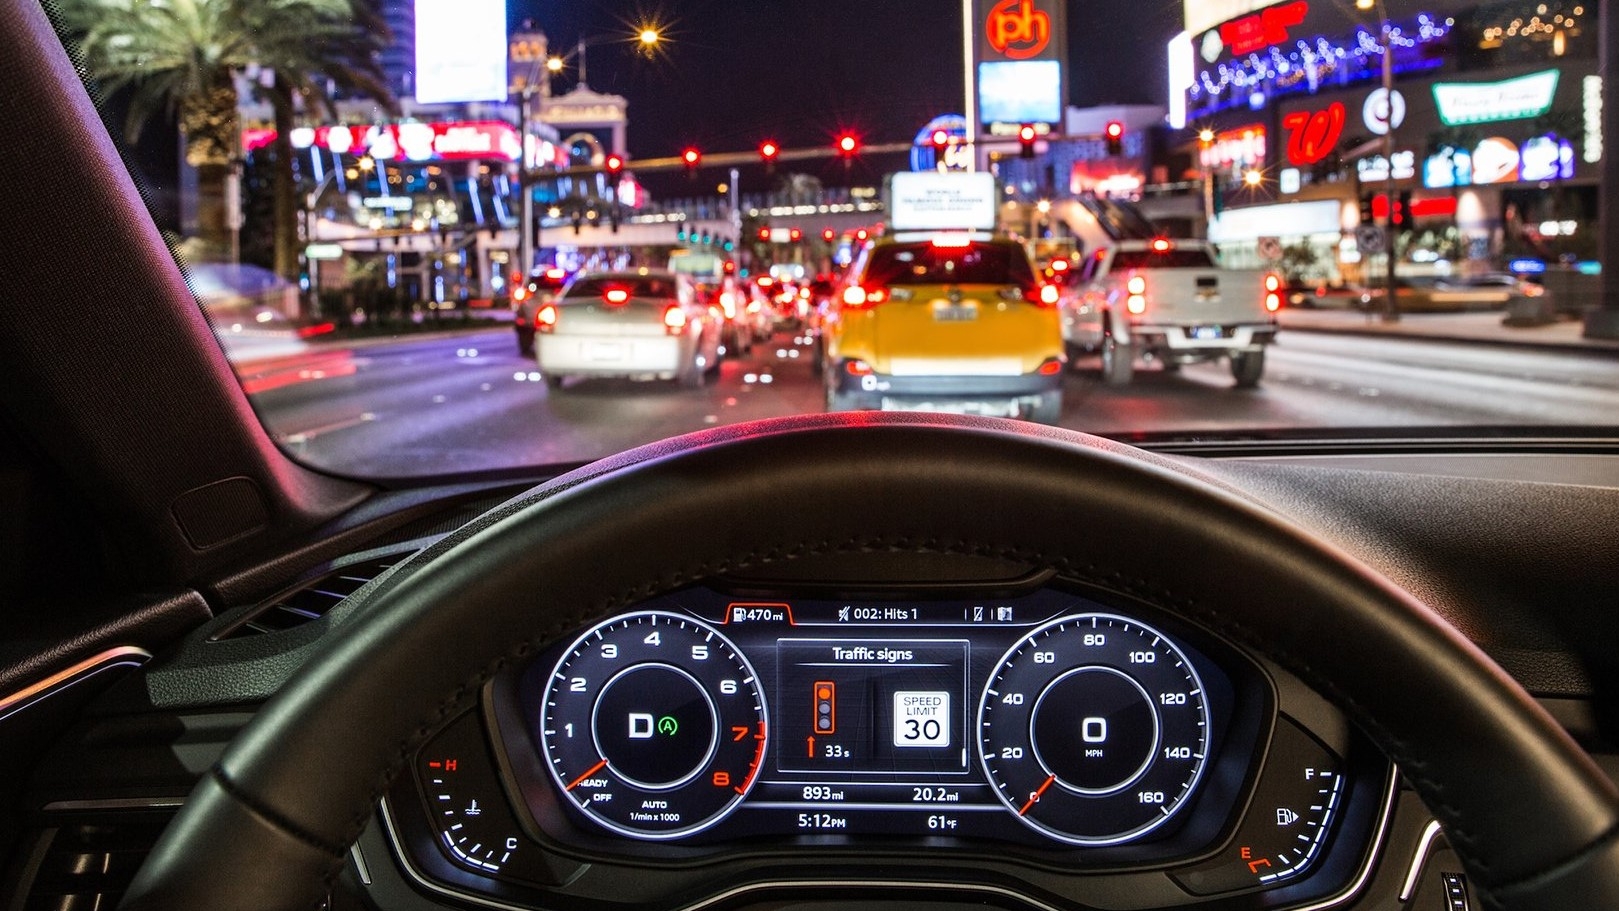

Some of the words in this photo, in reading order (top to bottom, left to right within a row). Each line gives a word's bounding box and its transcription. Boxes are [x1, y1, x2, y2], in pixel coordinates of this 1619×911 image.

[1282, 101, 1346, 166] W
[854, 608, 881, 620] 002:
[884, 608, 908, 620] Hits
[911, 608, 918, 620] 1
[644, 631, 661, 646] 4
[1084, 634, 1105, 646] 80
[601, 644, 618, 659] 3
[692, 645, 708, 660] 5
[833, 647, 874, 661] Traffic
[877, 648, 913, 664] signs
[1033, 651, 1055, 663] 60
[1129, 651, 1155, 663] 100
[570, 678, 587, 692] 2
[720, 679, 737, 694] 6
[903, 697, 941, 706] SPEED
[1002, 693, 1024, 705] 40
[1160, 693, 1186, 705] 120
[907, 706, 938, 716] LIMIT
[564, 723, 573, 738] 1
[628, 712, 654, 739] D
[904, 718, 940, 741] 30
[1082, 716, 1107, 743] 0
[731, 726, 748, 742] 7
[1002, 747, 1023, 759] 20
[1085, 750, 1103, 758] MPH
[1164, 747, 1190, 759] 140
[445, 759, 457, 771] H
[713, 772, 729, 786] 8
[1305, 768, 1314, 780] F
[593, 792, 612, 802] OFF
[1138, 792, 1164, 804] 160
[642, 800, 668, 809] AUTO
[630, 812, 652, 822] 1/min
[660, 813, 680, 822] 1000
[506, 837, 518, 849] C
[1241, 847, 1251, 859] E
